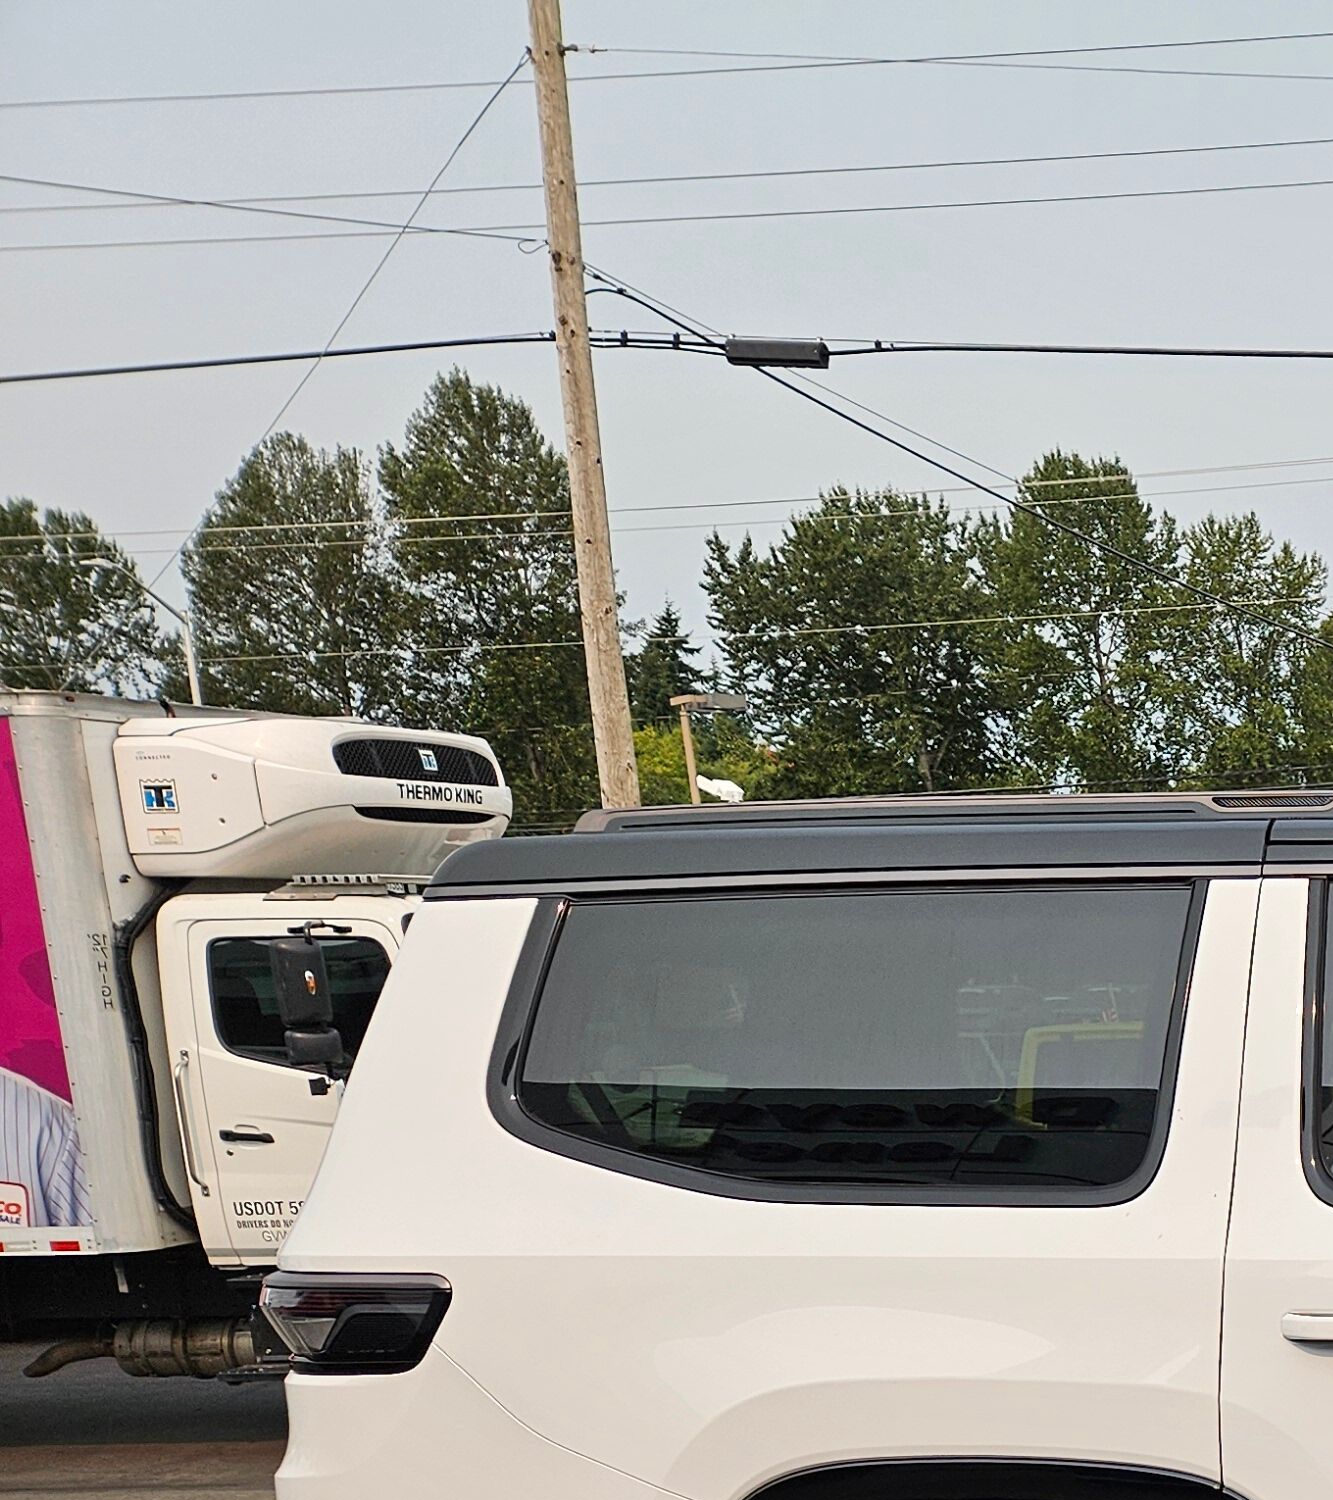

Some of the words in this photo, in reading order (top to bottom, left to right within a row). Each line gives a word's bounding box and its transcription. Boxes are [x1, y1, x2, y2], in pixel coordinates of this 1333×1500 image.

[396, 782, 453, 802] THERMO
[455, 788, 483, 805] KING
[232, 1200, 285, 1217] USDOT
[236, 1219, 269, 1229] DRIVERS
[261, 1230, 288, 1242] GVW
